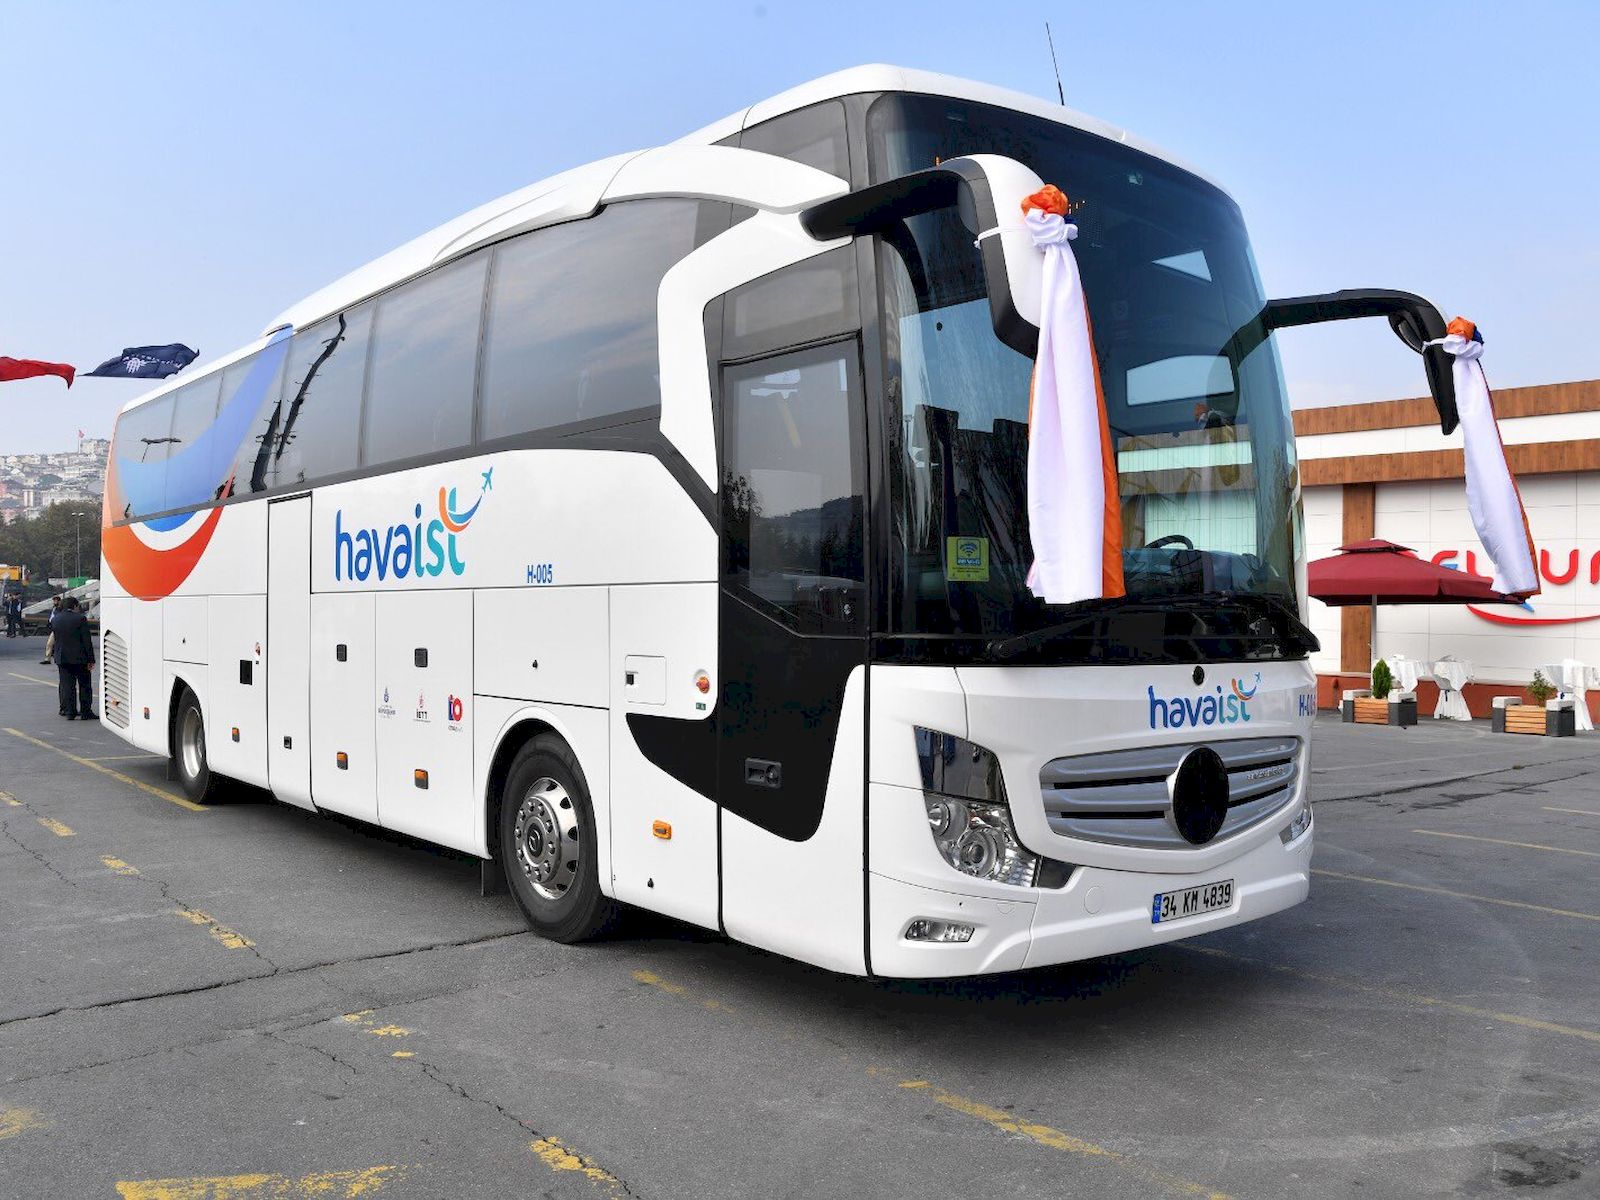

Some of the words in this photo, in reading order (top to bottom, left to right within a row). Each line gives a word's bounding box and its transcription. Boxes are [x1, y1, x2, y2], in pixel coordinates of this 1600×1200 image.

[335, 486, 474, 581] havaist
[527, 564, 553, 584] H-005
[1148, 678, 1251, 729] havaist
[1161, 895, 1177, 918] 34
[1182, 890, 1199, 913] KM
[1203, 883, 1231, 909] 4839
